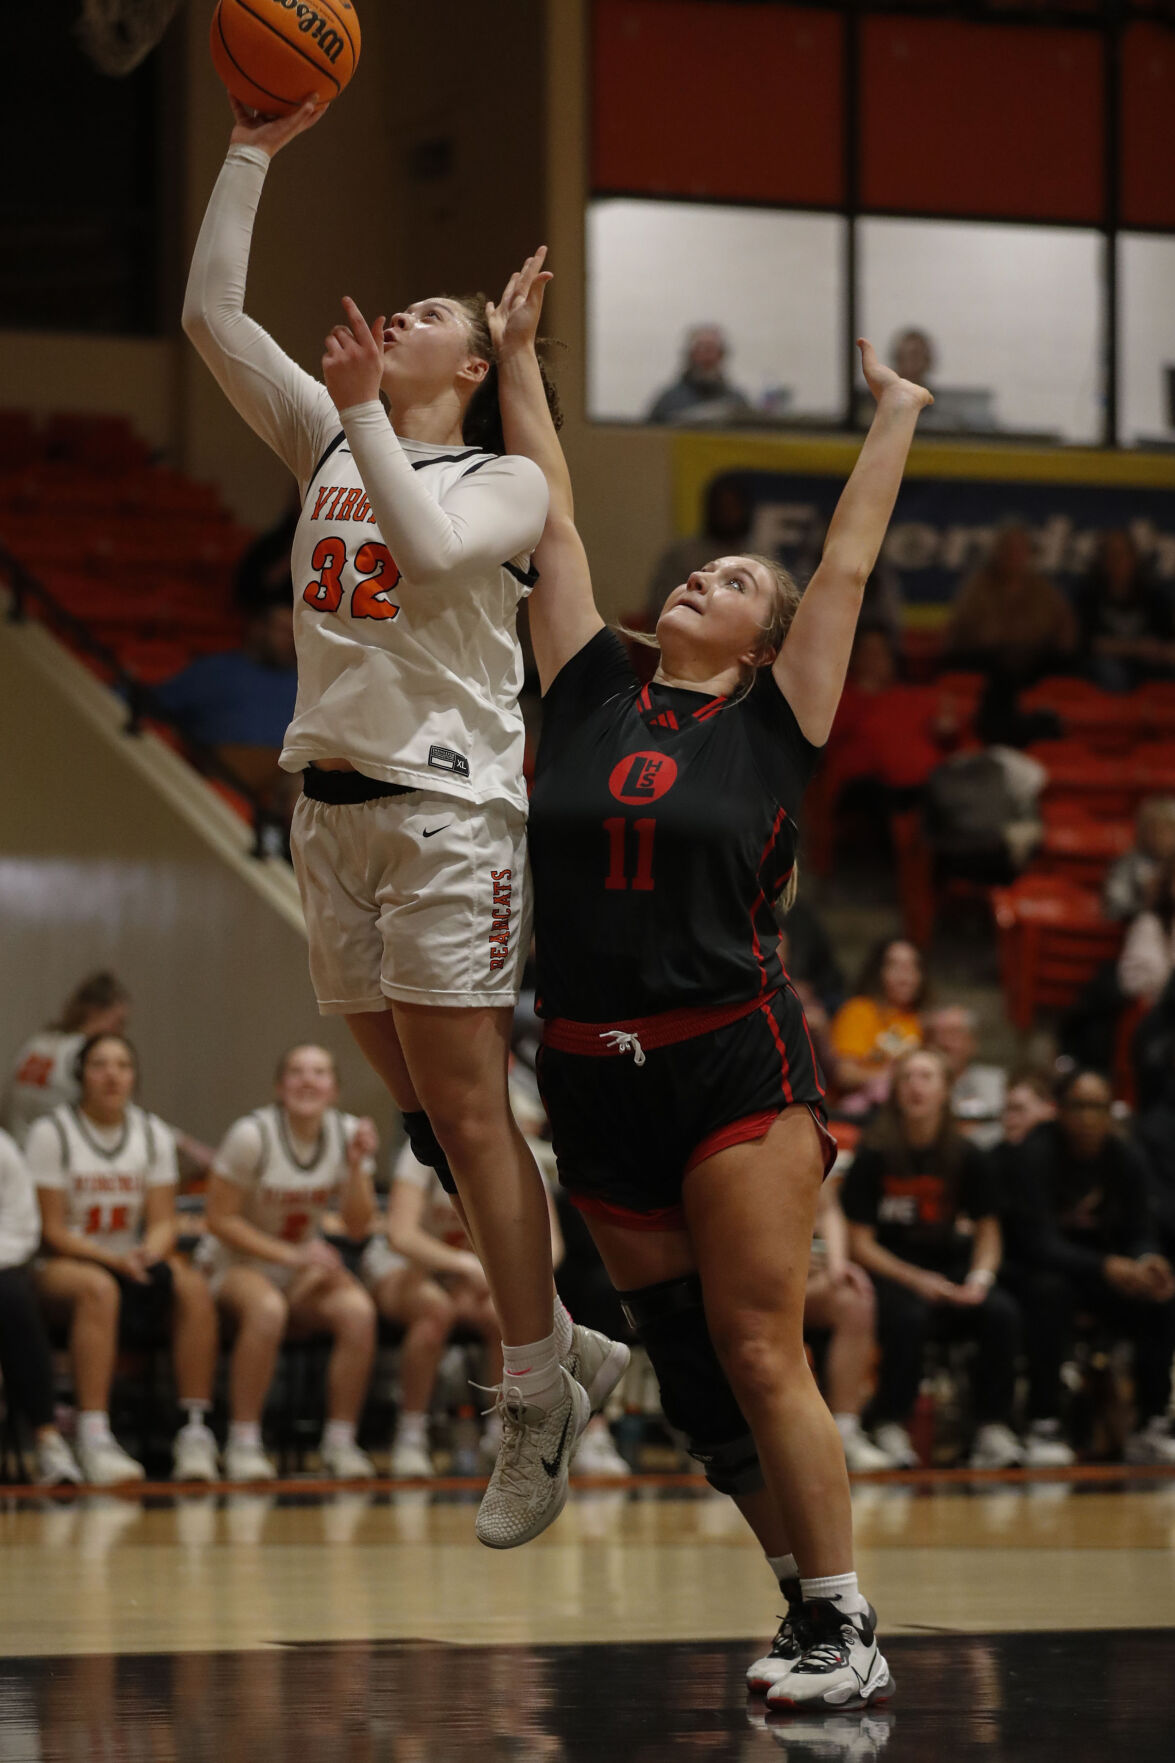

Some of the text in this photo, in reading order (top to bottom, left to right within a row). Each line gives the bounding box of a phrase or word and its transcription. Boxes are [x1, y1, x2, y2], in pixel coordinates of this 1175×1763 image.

[273, 0, 345, 64] Wilso
[310, 486, 377, 524] VIRG
[302, 536, 402, 620] 32
[456, 759, 467, 770] XL
[603, 817, 656, 891] 11
[489, 868, 512, 971] BEARCATS
